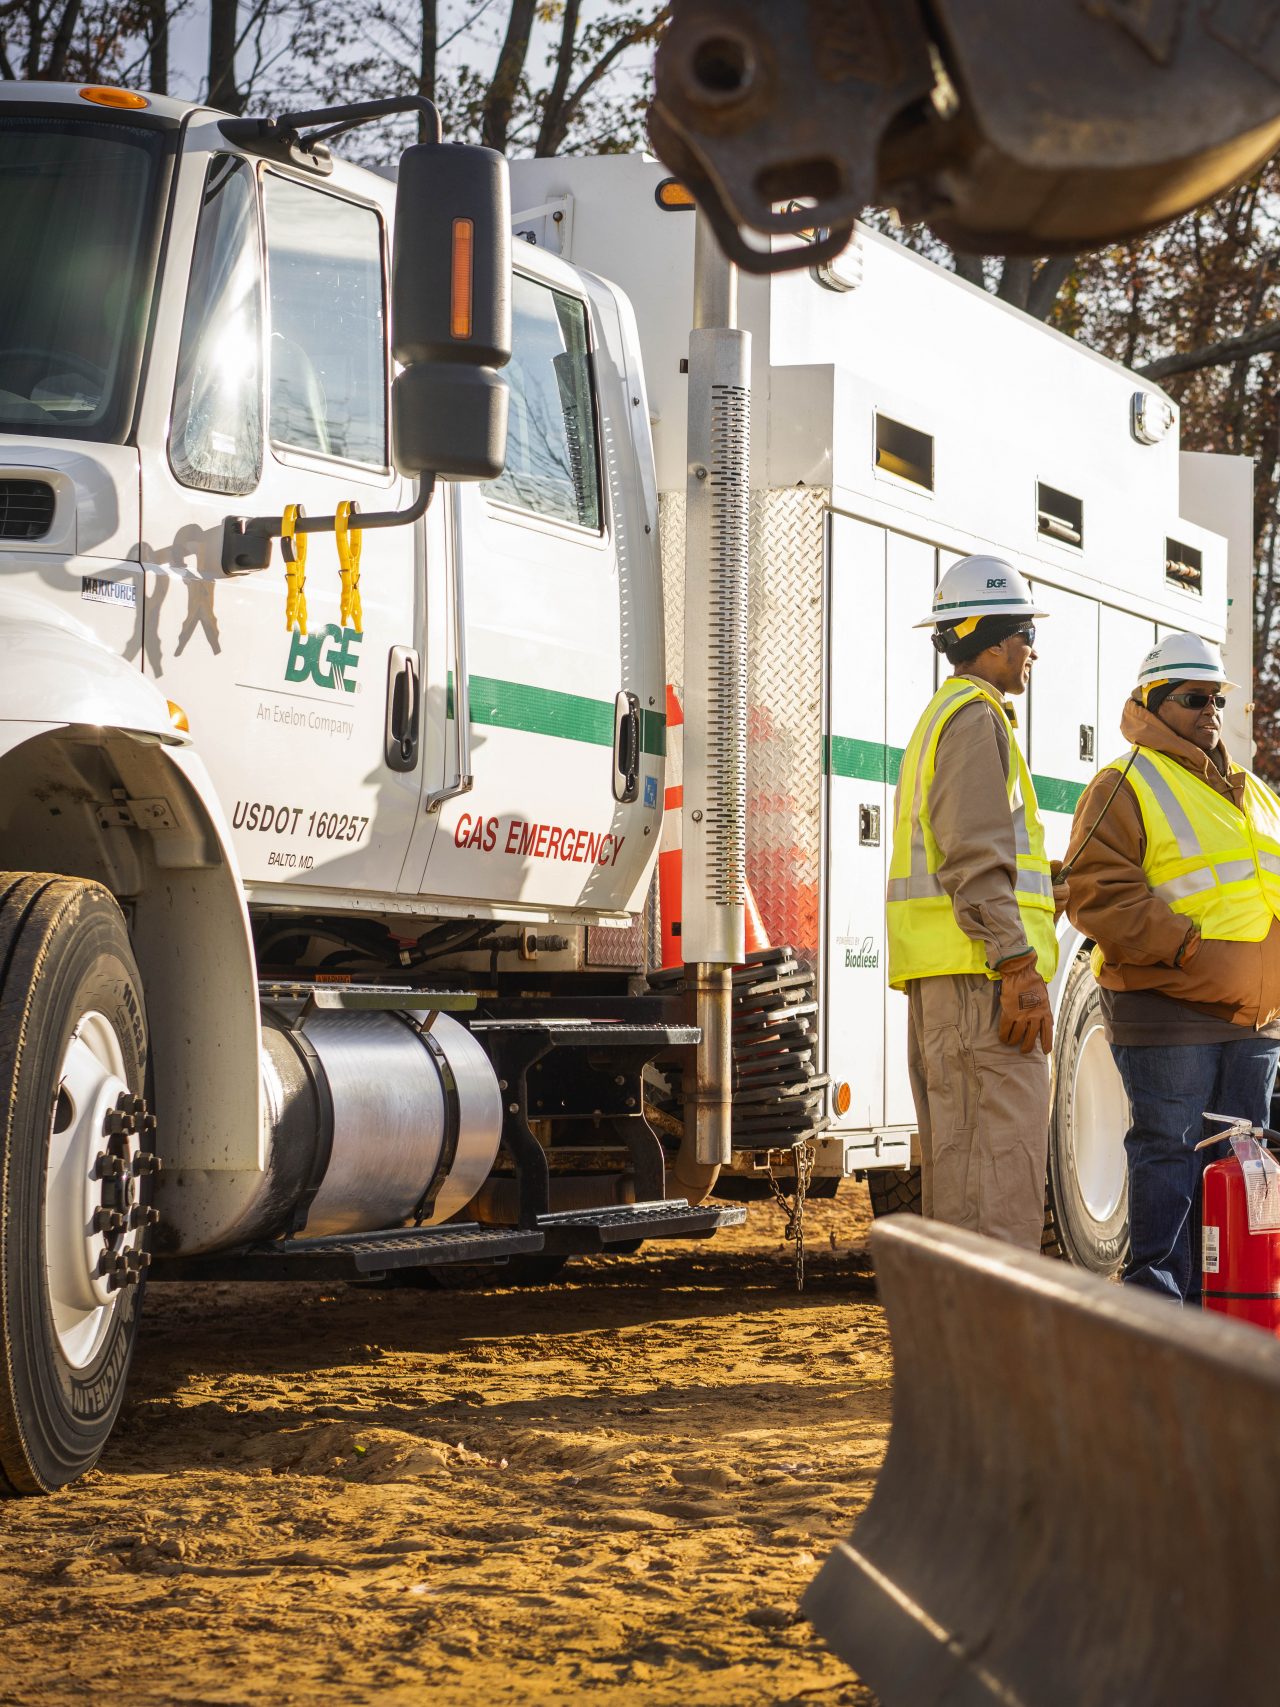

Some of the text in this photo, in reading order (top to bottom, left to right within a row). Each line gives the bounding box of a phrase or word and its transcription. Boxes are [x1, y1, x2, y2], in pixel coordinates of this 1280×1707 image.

[82, 575, 137, 602] MAXXFORCE
[986, 578, 1007, 589] BGE
[284, 622, 364, 693] BGE
[256, 702, 354, 741] An Exelon Company
[232, 800, 370, 842] USDOT 160257
[454, 812, 626, 867] GAS EMERGENCY
[298, 855, 314, 870] MD.
[845, 949, 879, 968] Biodiesel
[73, 1325, 128, 1414] MICHELIN
